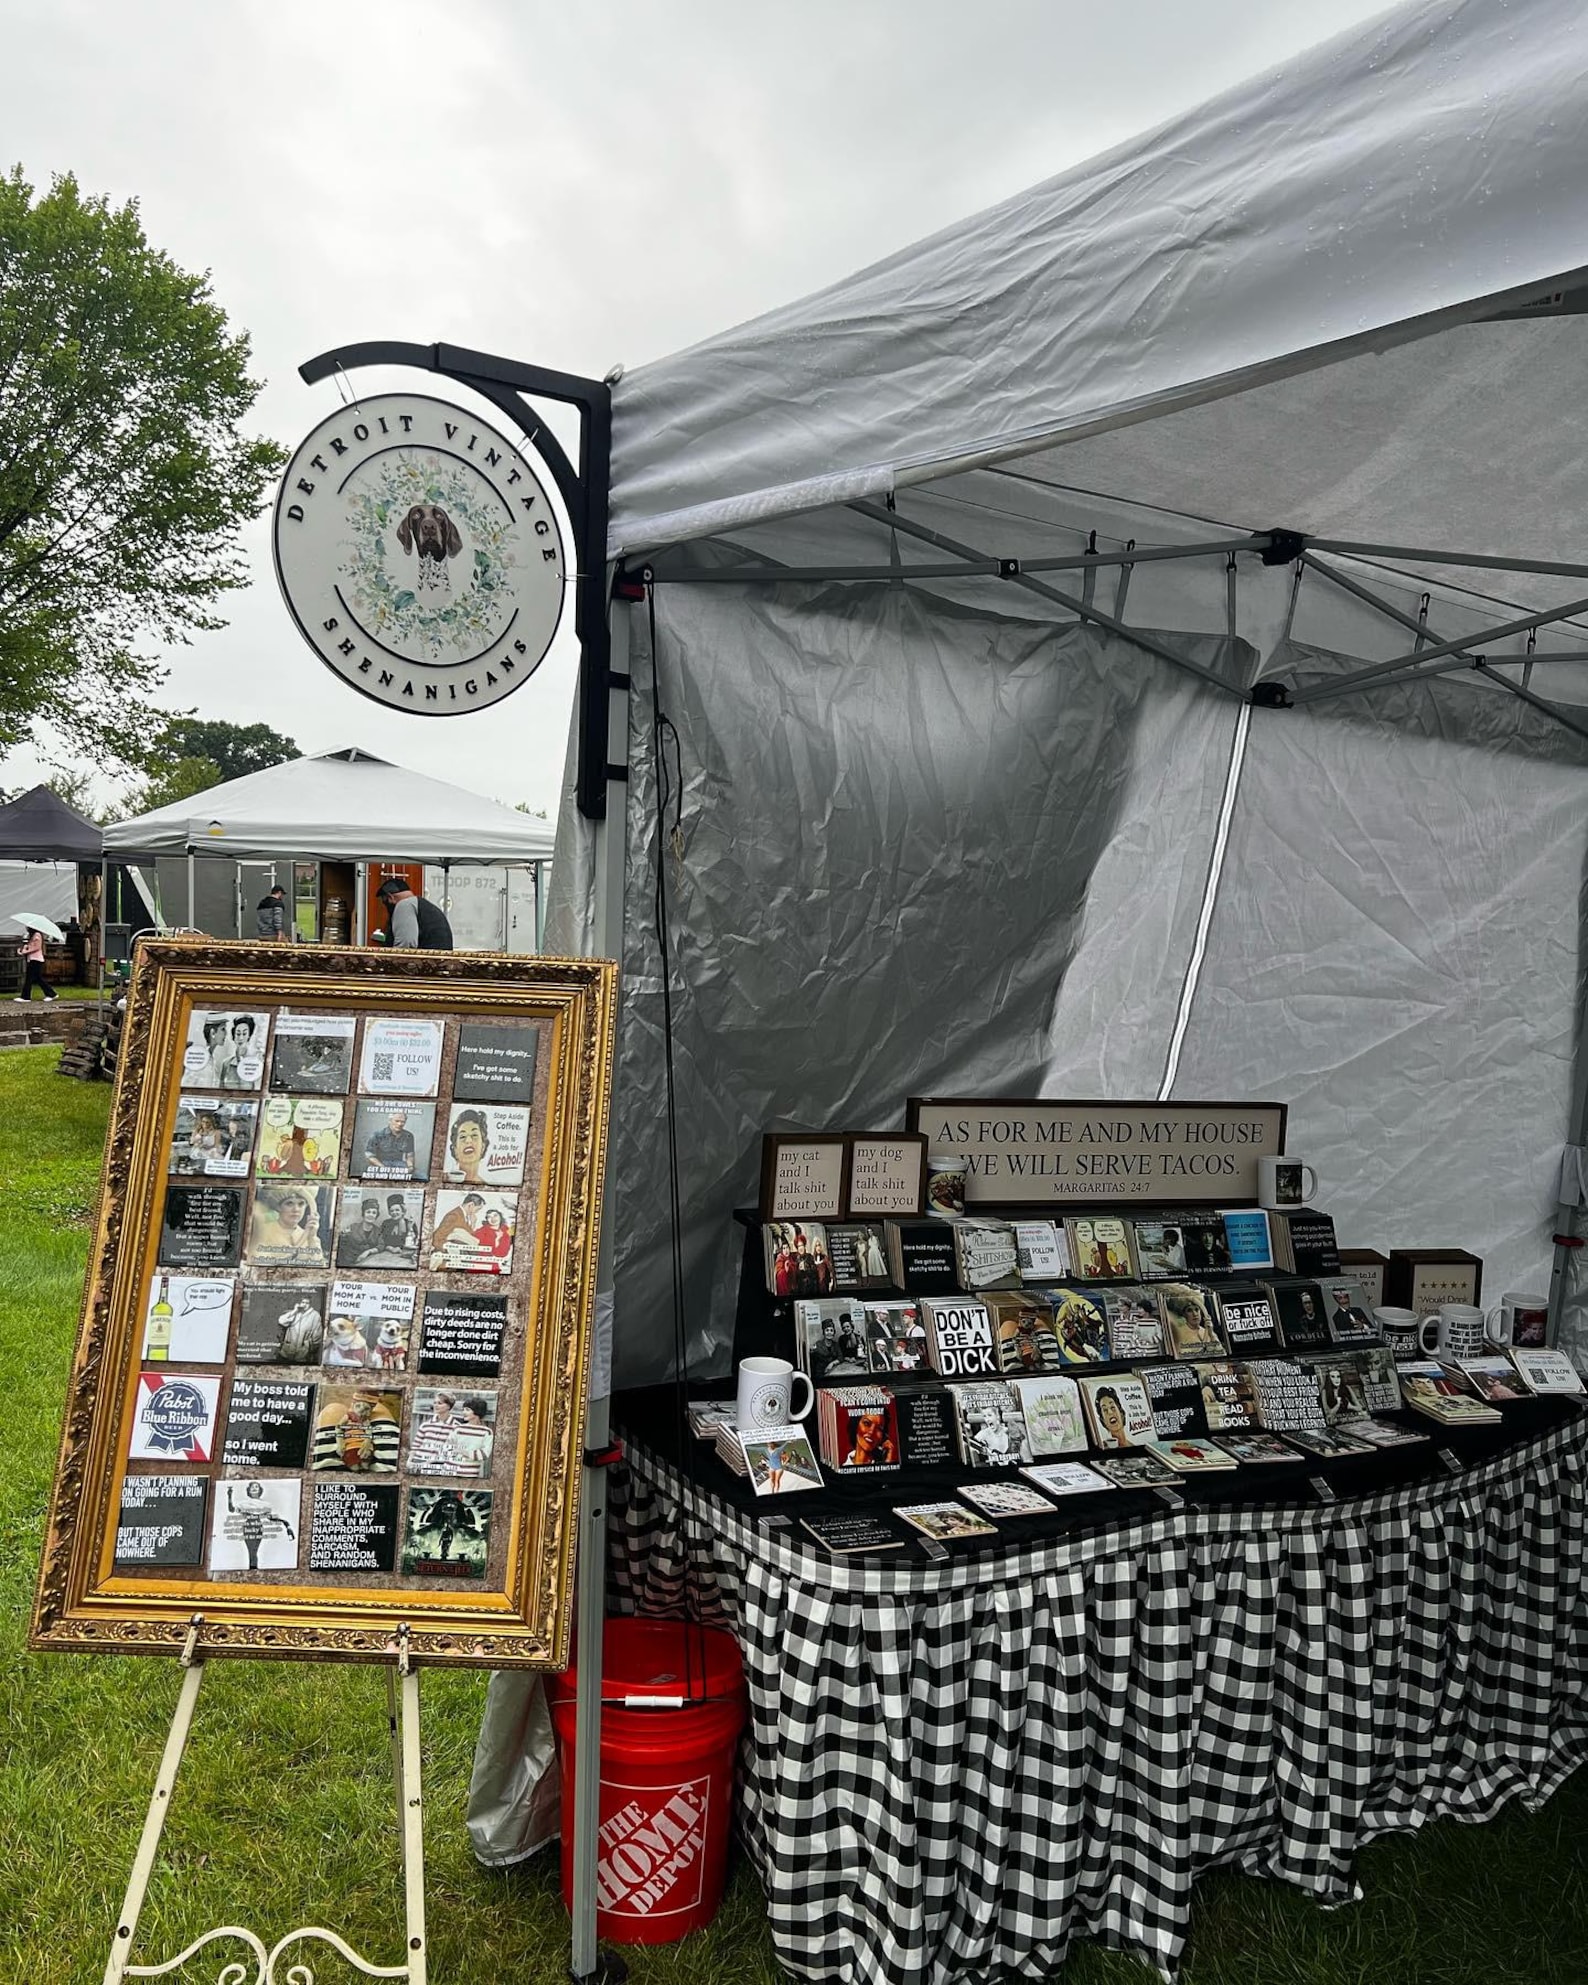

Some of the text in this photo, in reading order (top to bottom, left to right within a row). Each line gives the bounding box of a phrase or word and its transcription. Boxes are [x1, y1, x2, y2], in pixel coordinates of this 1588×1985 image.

[288, 415, 557, 562] DETROIT VINTAGE
[323, 617, 526, 699] SHENANIGANS
[475, 878, 496, 888] 872
[494, 1048, 505, 1056] my
[397, 1054, 432, 1064] FOLLOW
[406, 1067, 418, 1076] US!
[473, 1064, 485, 1072] I've
[486, 1065, 497, 1074] got
[463, 1073, 489, 1082] sketchy
[494, 1113, 507, 1121] Step
[496, 1122, 521, 1131] Coffee.
[937, 1122, 1264, 1143] AS FOR ME AND MY HOUSE
[781, 1150, 820, 1161] my cat
[857, 1146, 903, 1161] my dog
[488, 1153, 522, 1166] Alcohol!
[961, 1154, 1240, 1175] WE WILL SERVE TACOS.
[780, 1166, 809, 1177] and I
[857, 1162, 887, 1173] and I
[779, 1183, 827, 1194] talk shit
[856, 1178, 905, 1189] talk shit
[1053, 1182, 1125, 1192] MARGARITAS
[777, 1199, 834, 1212] about you
[855, 1194, 913, 1207] about you
[381, 1304, 410, 1312] PUBLIC
[425, 1306, 505, 1320] Due to rising costs,
[1226, 1304, 1269, 1319] be nice
[424, 1317, 445, 1327] dirty
[447, 1319, 473, 1327] deeds
[492, 1322, 503, 1330] no
[936, 1308, 985, 1332] DON'T
[1228, 1317, 1271, 1330] or fuck off
[427, 1328, 498, 1340] longer done dirt
[944, 1331, 985, 1347] BE A
[427, 1339, 496, 1351] cheap. Sorry for
[420, 1350, 501, 1362] the inconvenience.
[940, 1348, 996, 1375] DICK
[1211, 1375, 1238, 1384] DRINK
[234, 1382, 308, 1396] My boss told
[1217, 1387, 1237, 1396] TEA
[158, 1391, 195, 1409] Pabst
[231, 1397, 305, 1410] me to have a
[1219, 1405, 1243, 1414] READ
[142, 1412, 207, 1426] Blue Ribbon
[229, 1411, 291, 1424] good day...
[1219, 1417, 1250, 1427] BOOKS
[242, 1440, 246, 1449] I
[248, 1440, 277, 1451] went
[223, 1454, 260, 1465] home.
[128, 1478, 157, 1486] WASN'T
[159, 1477, 198, 1486] PLANNING
[123, 1487, 202, 1497] ON GOING FOR A RUN
[314, 1501, 352, 1509] MYSELF
[313, 1518, 344, 1526] SHARE
[118, 1527, 183, 1537] BUT THOSE COPS
[117, 1538, 168, 1547] CAME OUT OF
[312, 1535, 368, 1543] COMMENTS,
[116, 1547, 156, 1557] NOWHERE.
[311, 1543, 359, 1551] SARCASM,
[311, 1551, 375, 1559] AND RANDOM
[310, 1559, 379, 1567] SHENANIGANS.
[599, 1801, 649, 1848] THE
[598, 1784, 707, 1910] HOME
[628, 1828, 703, 1914] DEPOT
